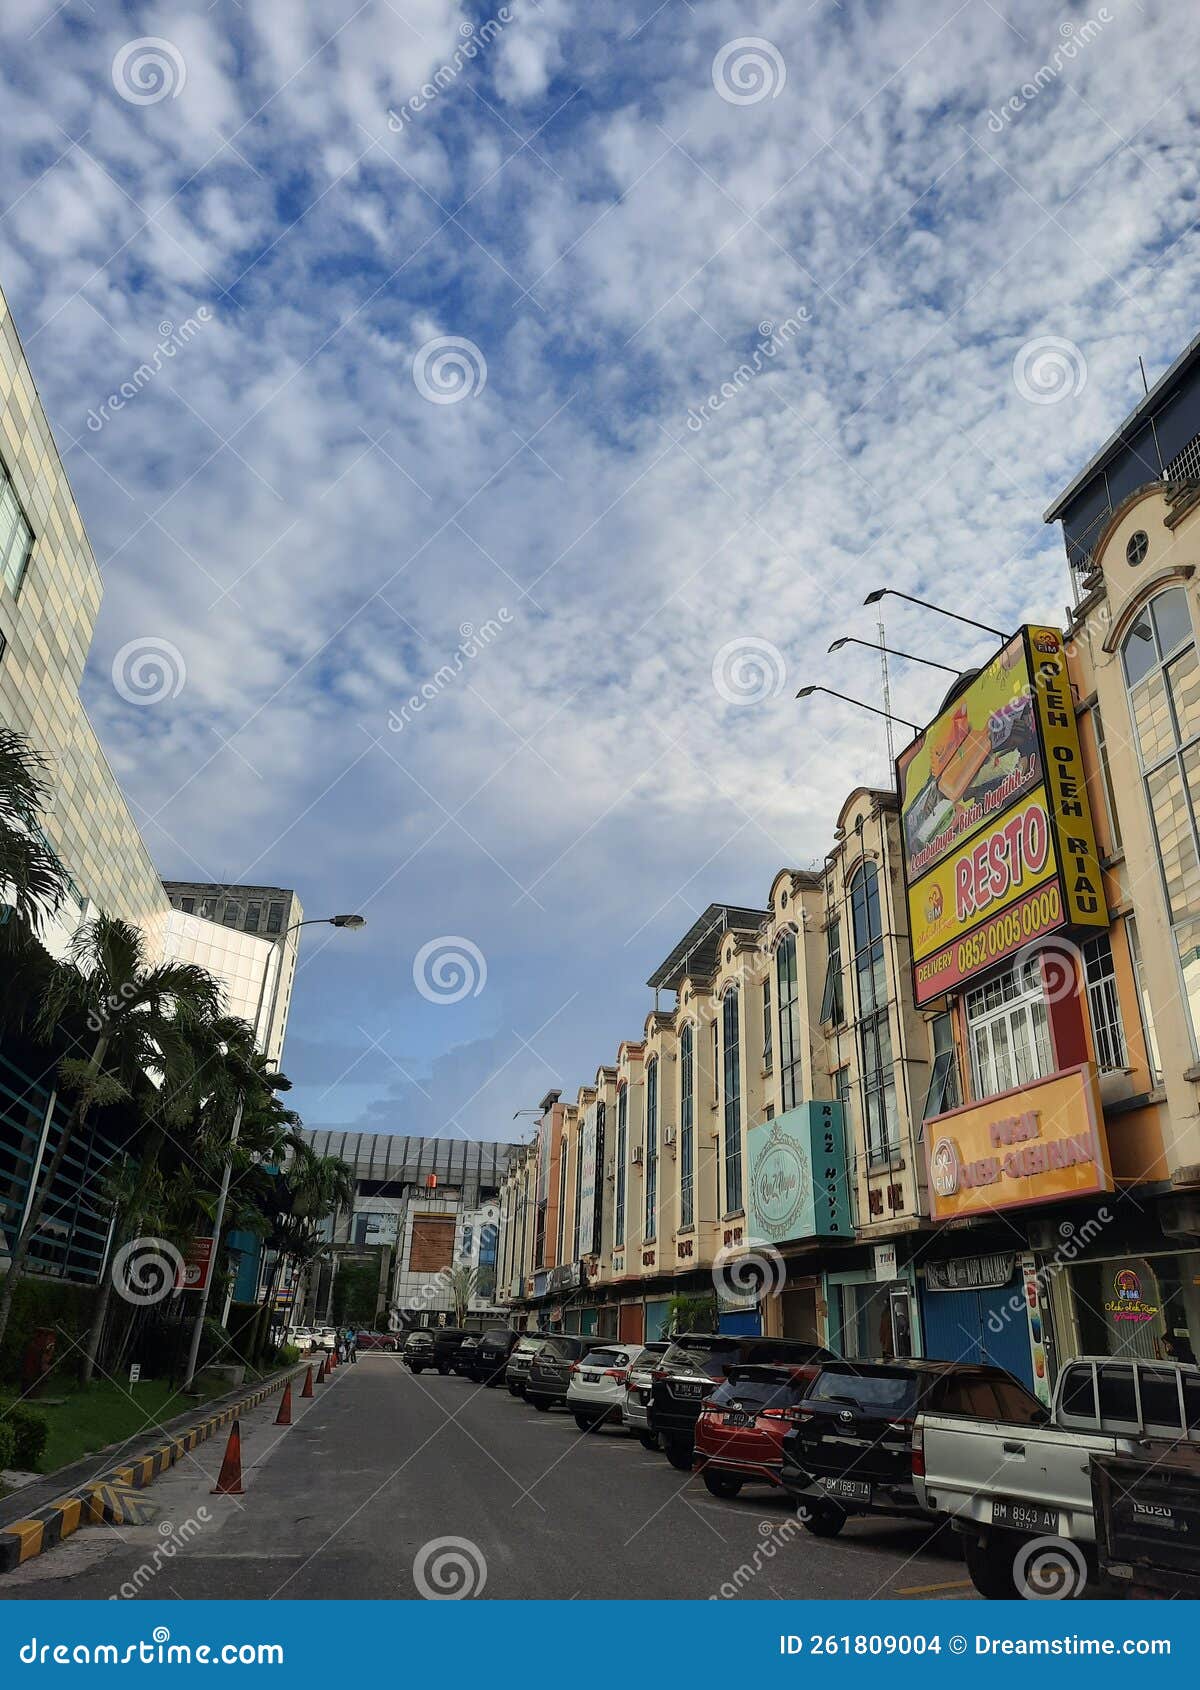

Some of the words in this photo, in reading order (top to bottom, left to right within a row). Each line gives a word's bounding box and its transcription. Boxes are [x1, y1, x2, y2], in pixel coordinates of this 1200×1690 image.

[1040, 661, 1068, 728] OLEH
[1053, 746, 1082, 817] OLEH
[955, 804, 1047, 921] RESTO
[1066, 838, 1098, 914] RIAU
[918, 951, 952, 983] DELIVERY
[958, 931, 987, 973] 0852
[988, 910, 1021, 956] 0005
[1022, 886, 1060, 936] 0000
[936, 1173, 954, 1188] FIM
[993, 1502, 1007, 1518] BM
[1013, 1506, 1038, 1523] 8943
[1044, 1511, 1057, 1527] AV
[1133, 1502, 1172, 1518] ISUZU
